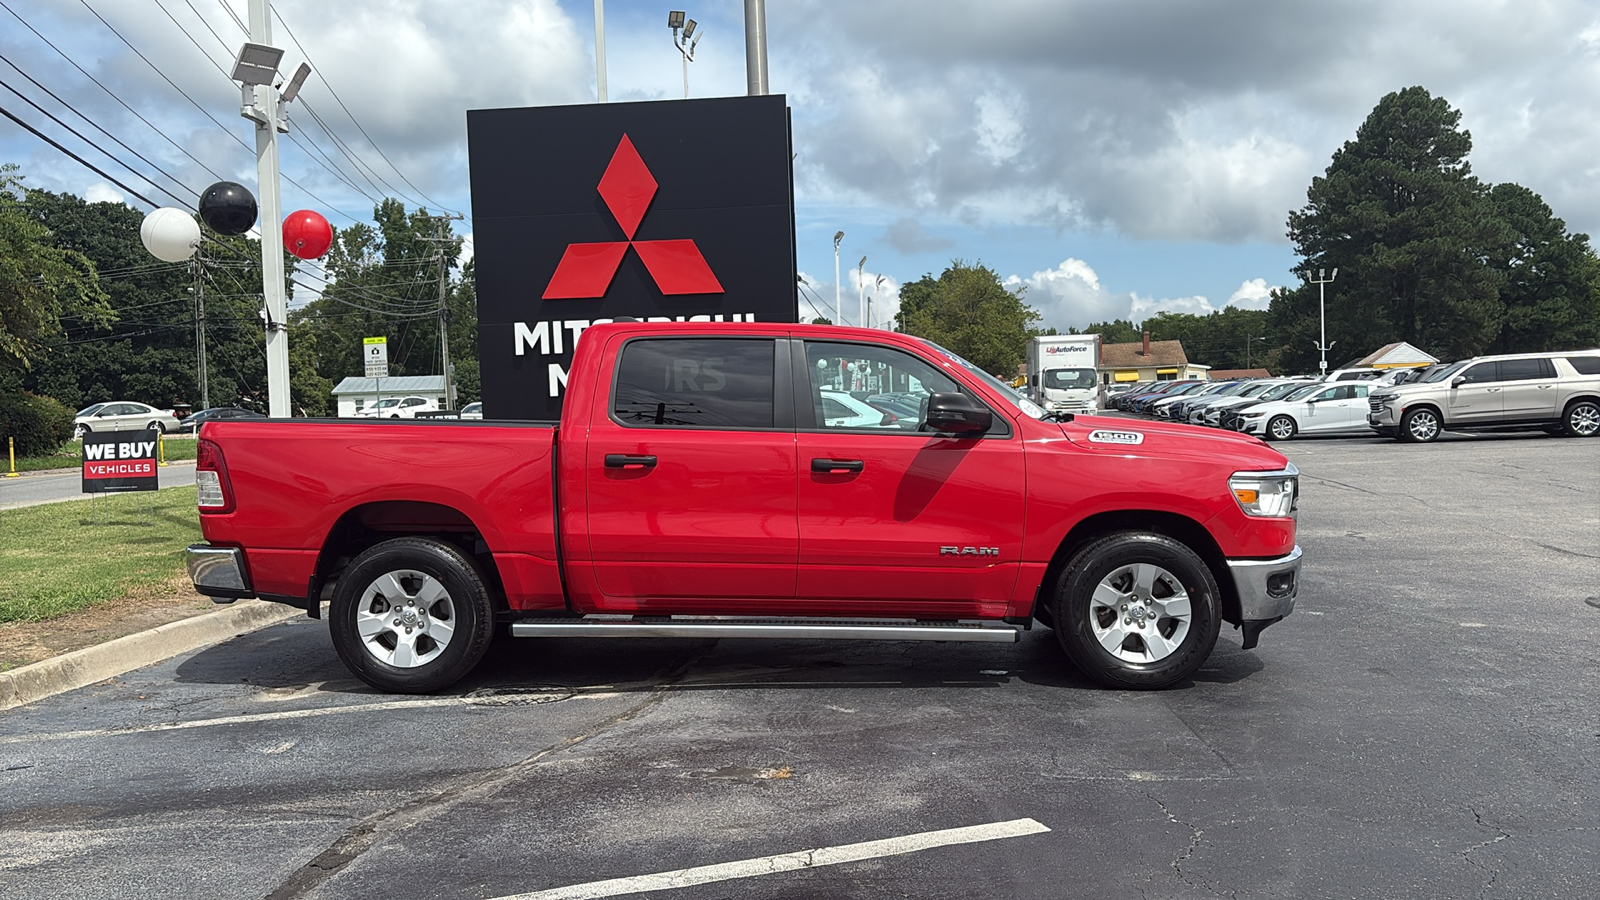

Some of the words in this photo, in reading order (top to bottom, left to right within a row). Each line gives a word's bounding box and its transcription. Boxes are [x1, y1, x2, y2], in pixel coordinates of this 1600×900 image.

[1094, 432, 1137, 440] 1500
[84, 443, 116, 460] WE
[119, 441, 156, 459] BUY
[89, 463, 151, 475] VEHICLES
[940, 546, 999, 555] RAM
